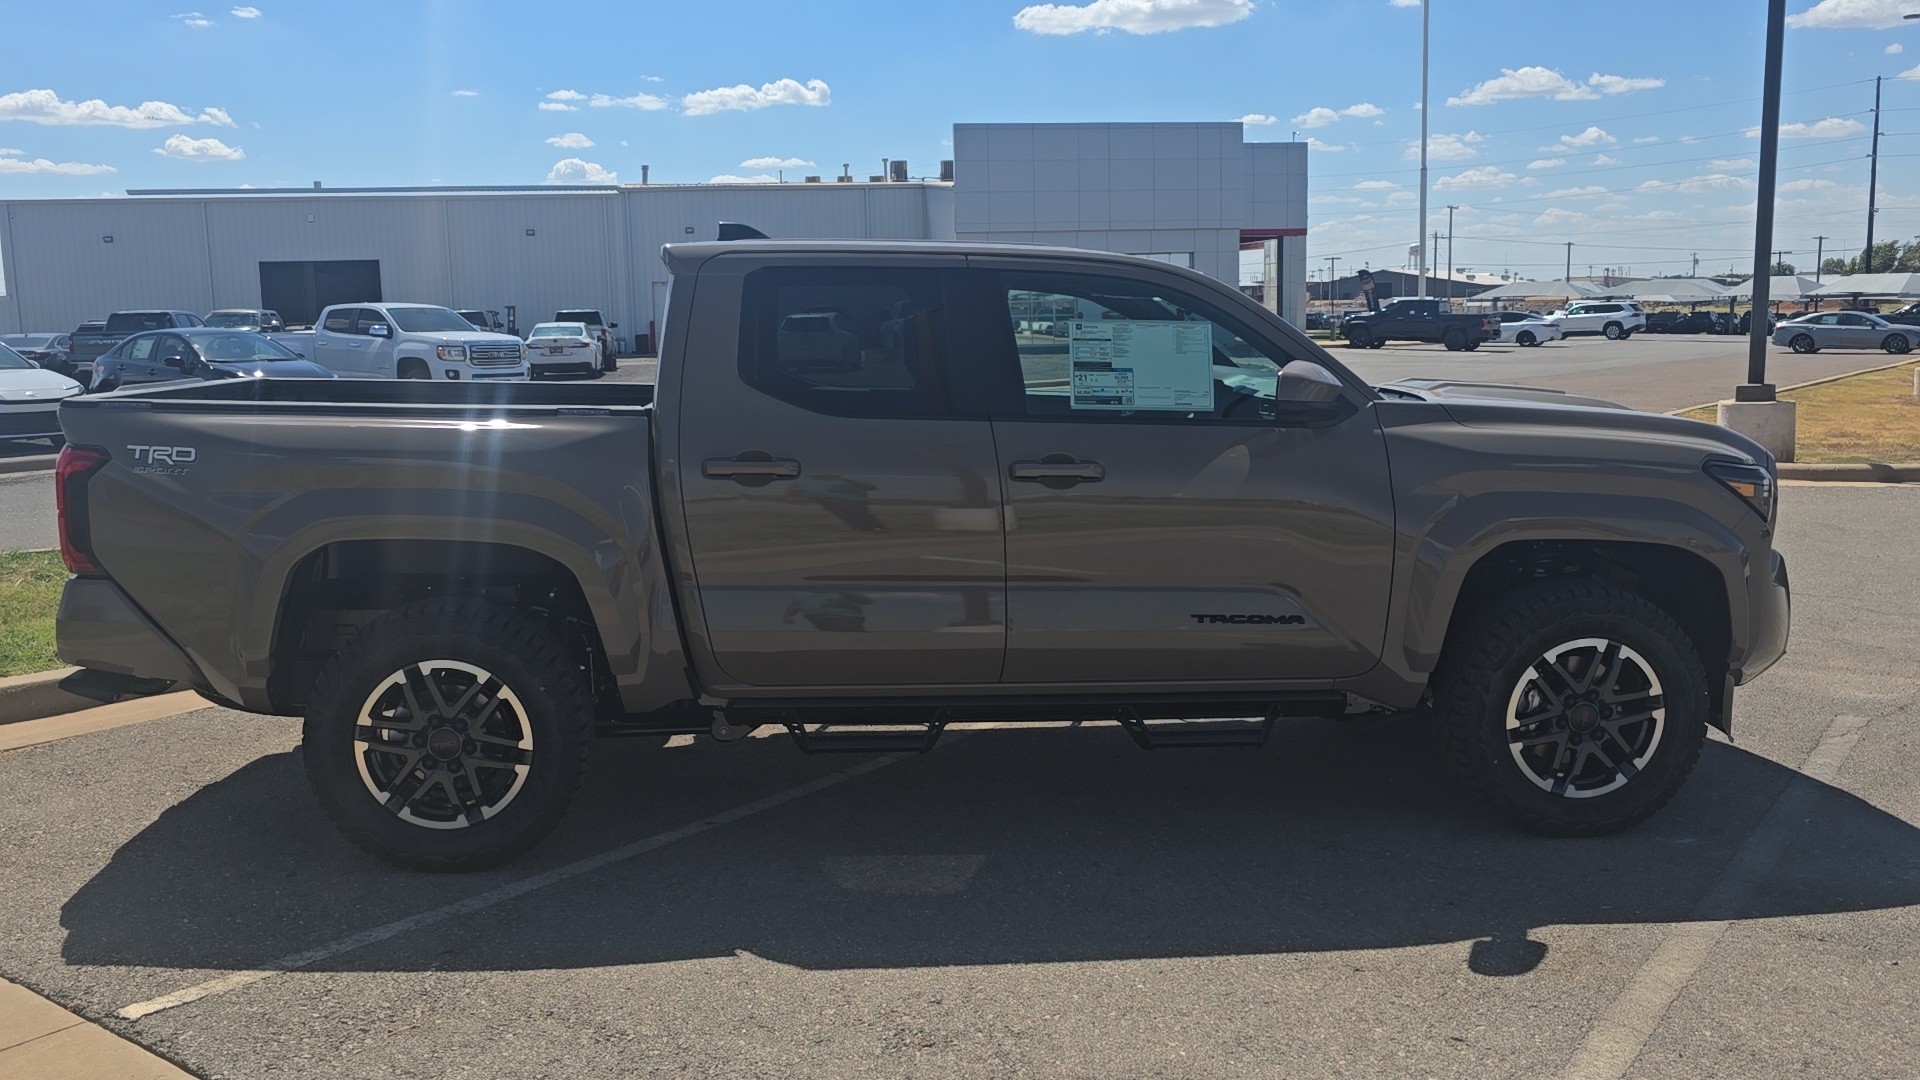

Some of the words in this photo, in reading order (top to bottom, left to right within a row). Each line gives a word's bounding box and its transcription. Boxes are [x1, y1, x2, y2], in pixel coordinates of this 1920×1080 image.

[1078, 373, 1087, 381] 21
[126, 444, 196, 465] TRD
[132, 466, 190, 475] SPORT
[1190, 614, 1305, 624] TACOMA
